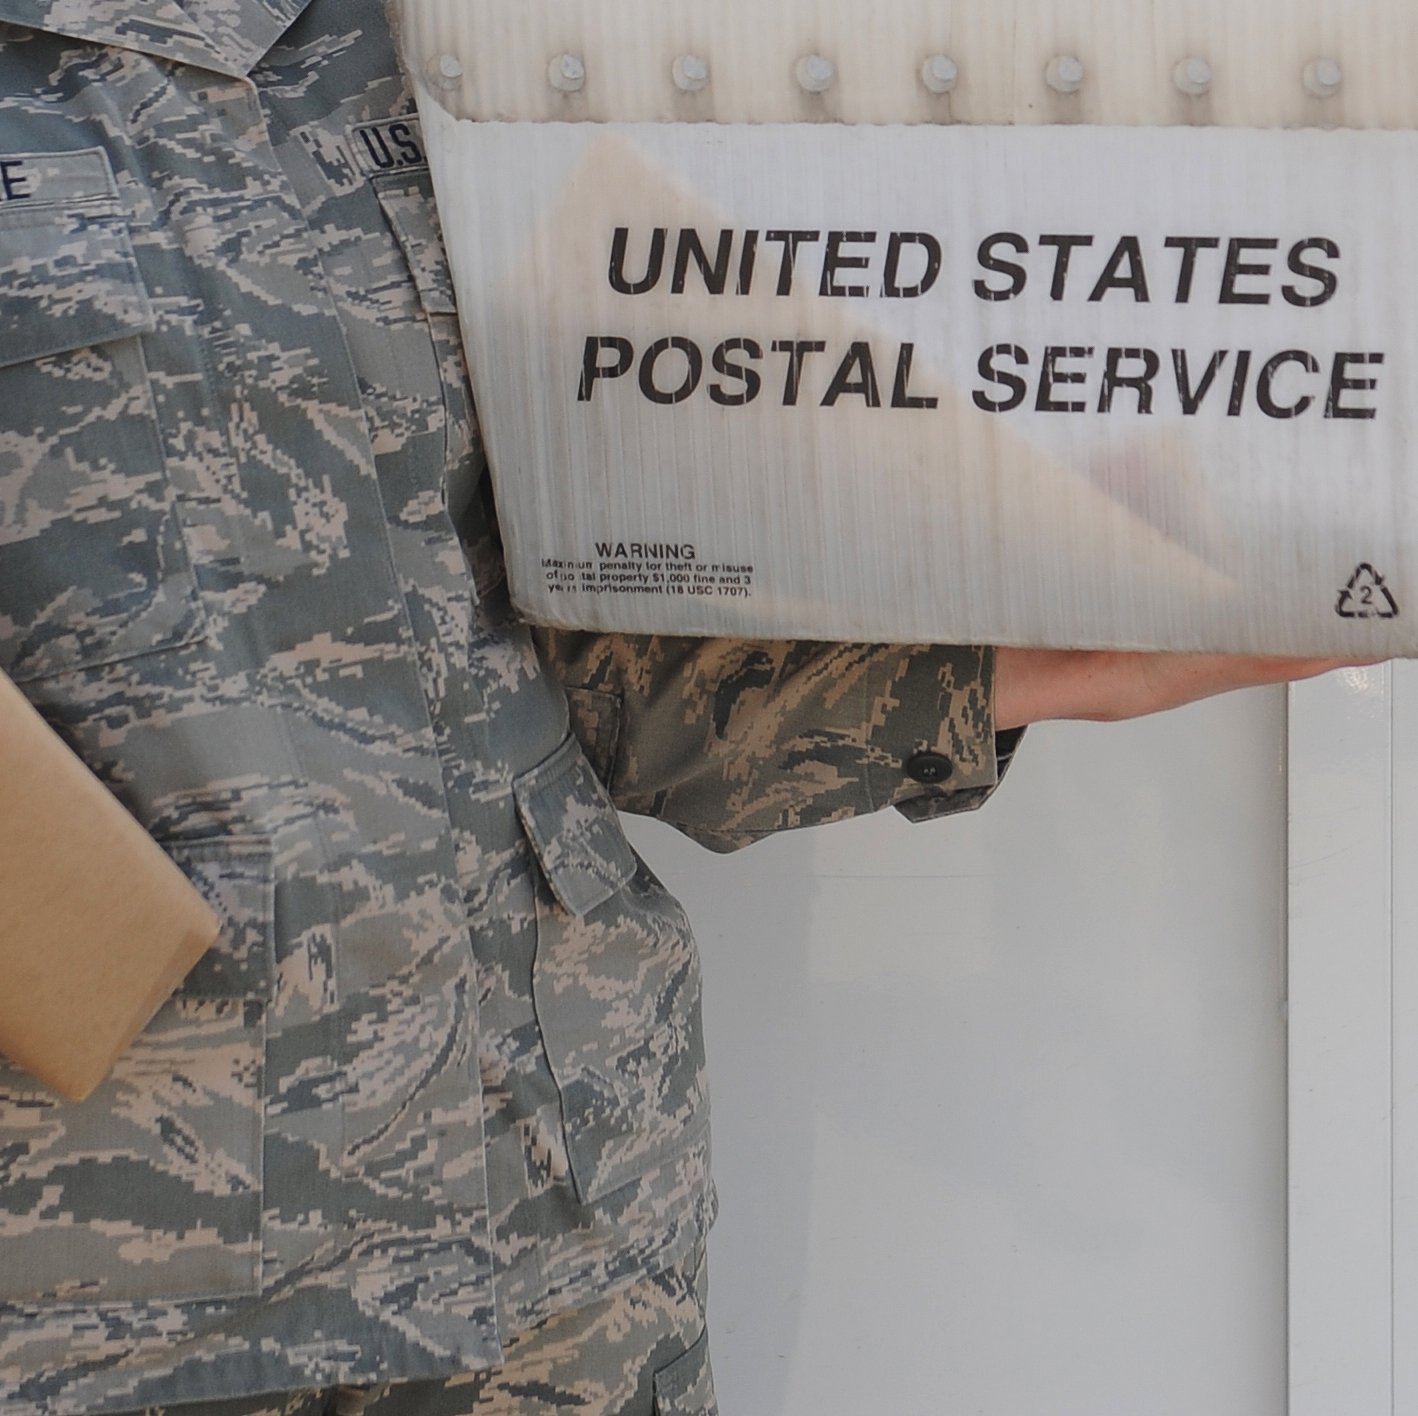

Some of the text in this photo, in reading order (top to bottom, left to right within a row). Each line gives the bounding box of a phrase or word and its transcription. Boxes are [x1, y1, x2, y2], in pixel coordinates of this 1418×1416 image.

[608, 227, 1341, 308] UNITED STATES
[577, 335, 1385, 420] POSTAL SERVICE
[595, 542, 696, 560] WARNING
[599, 561, 643, 572] penalty
[645, 562, 662, 571] for
[665, 562, 692, 572] theft
[546, 568, 752, 585] of potal property $1,000 fine and 3
[581, 583, 663, 595] imprisonment
[687, 585, 713, 596] USC
